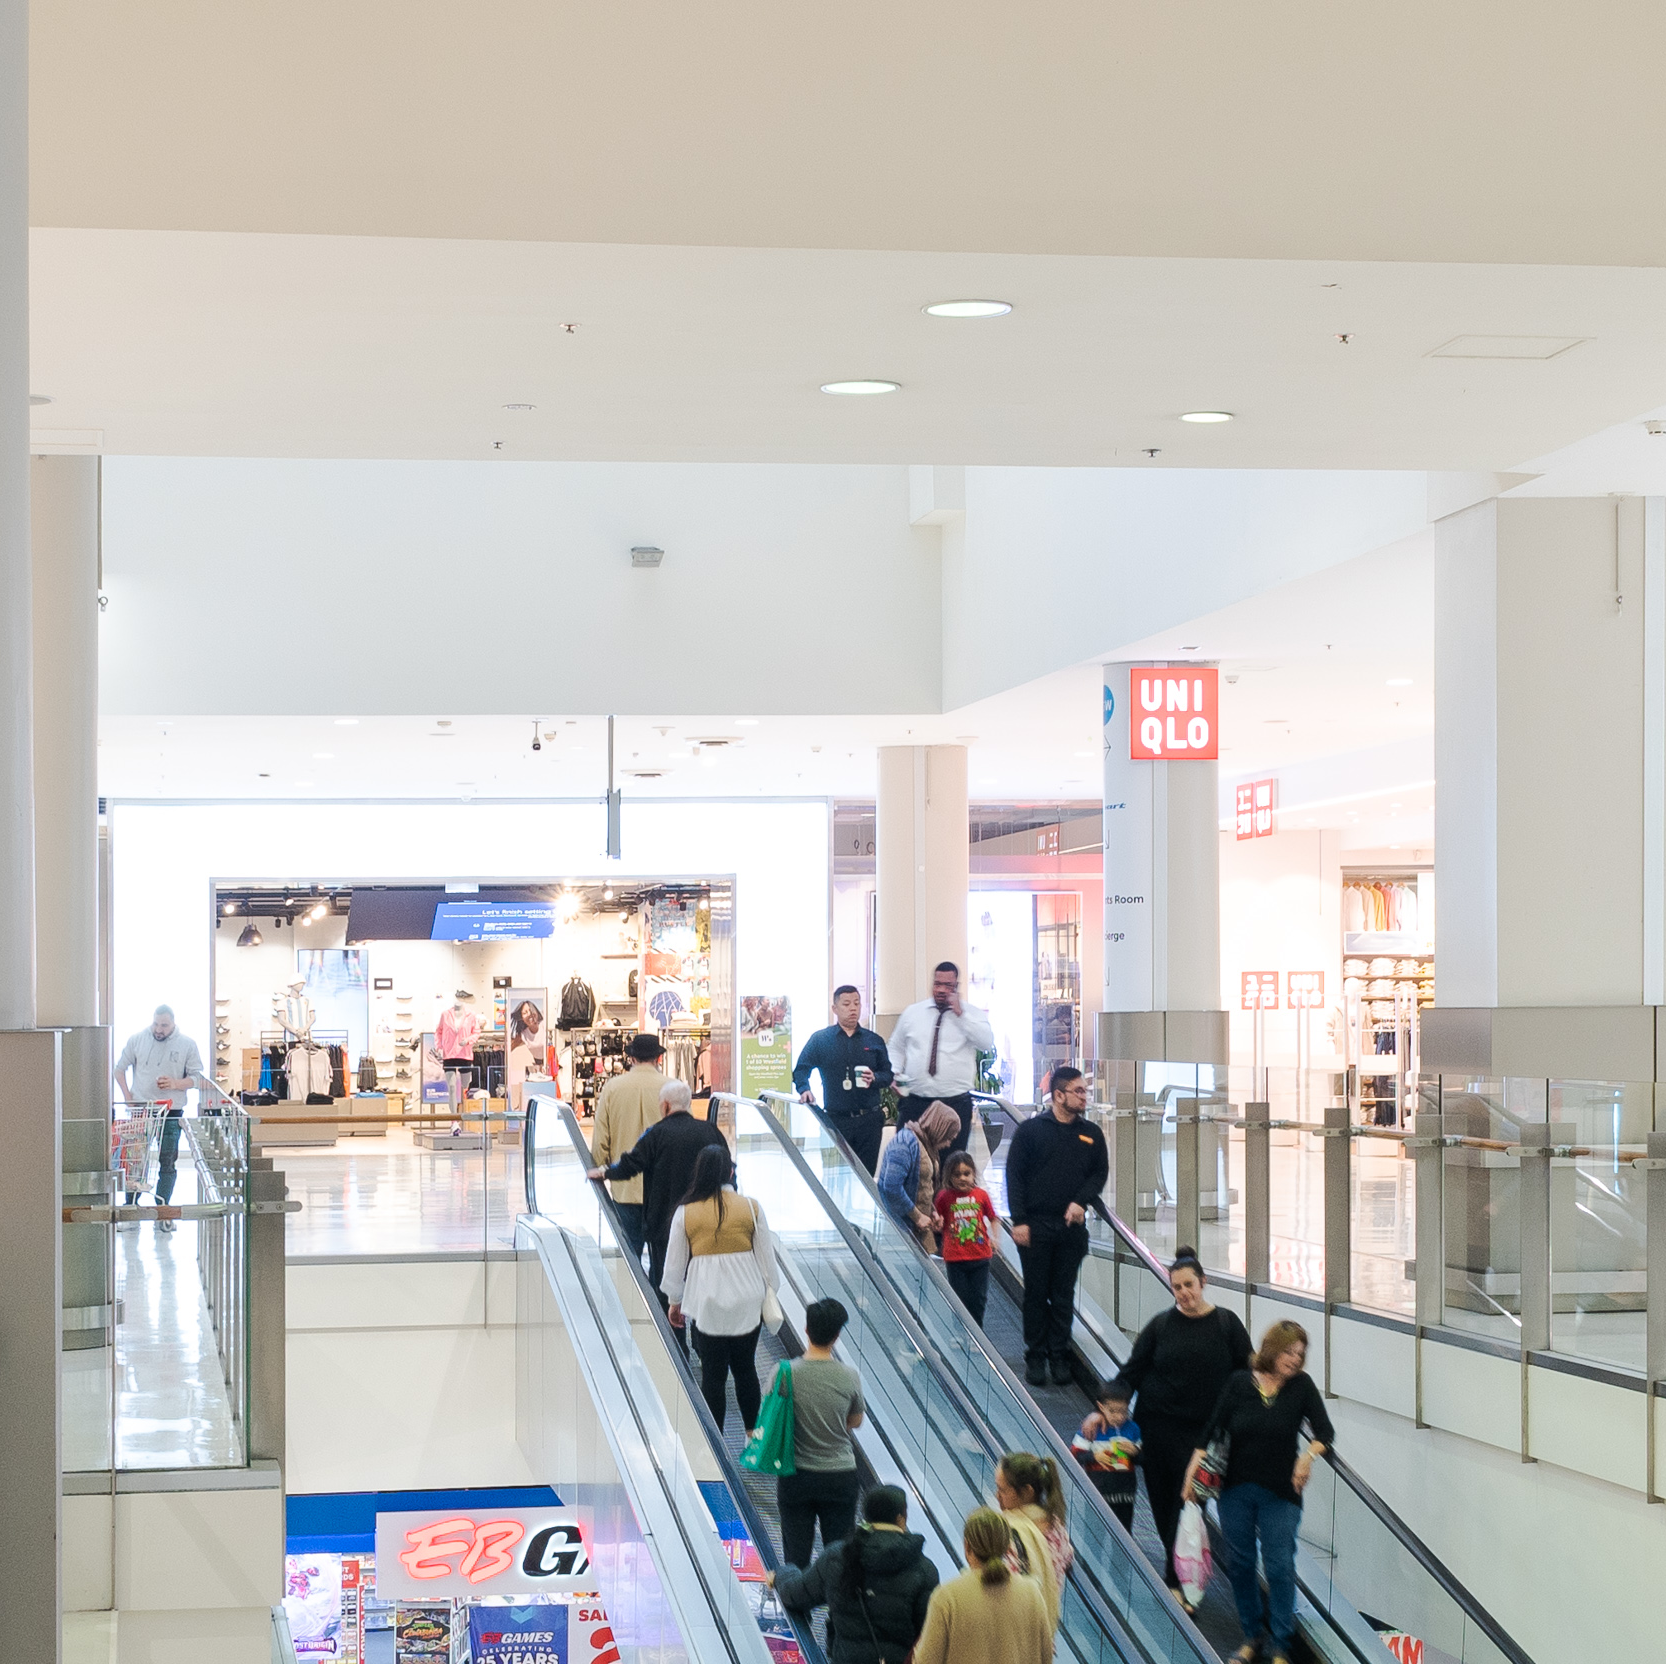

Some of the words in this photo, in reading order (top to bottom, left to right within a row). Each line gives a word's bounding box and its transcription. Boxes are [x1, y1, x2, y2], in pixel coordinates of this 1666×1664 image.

[1140, 679, 1202, 711] UNI
[1140, 716, 1209, 754] QLO
[1114, 895, 1144, 904] Room
[399, 1517, 525, 1584] EB
[501, 1631, 554, 1644] GAMES
[482, 1645, 552, 1655] CELEBRATING
